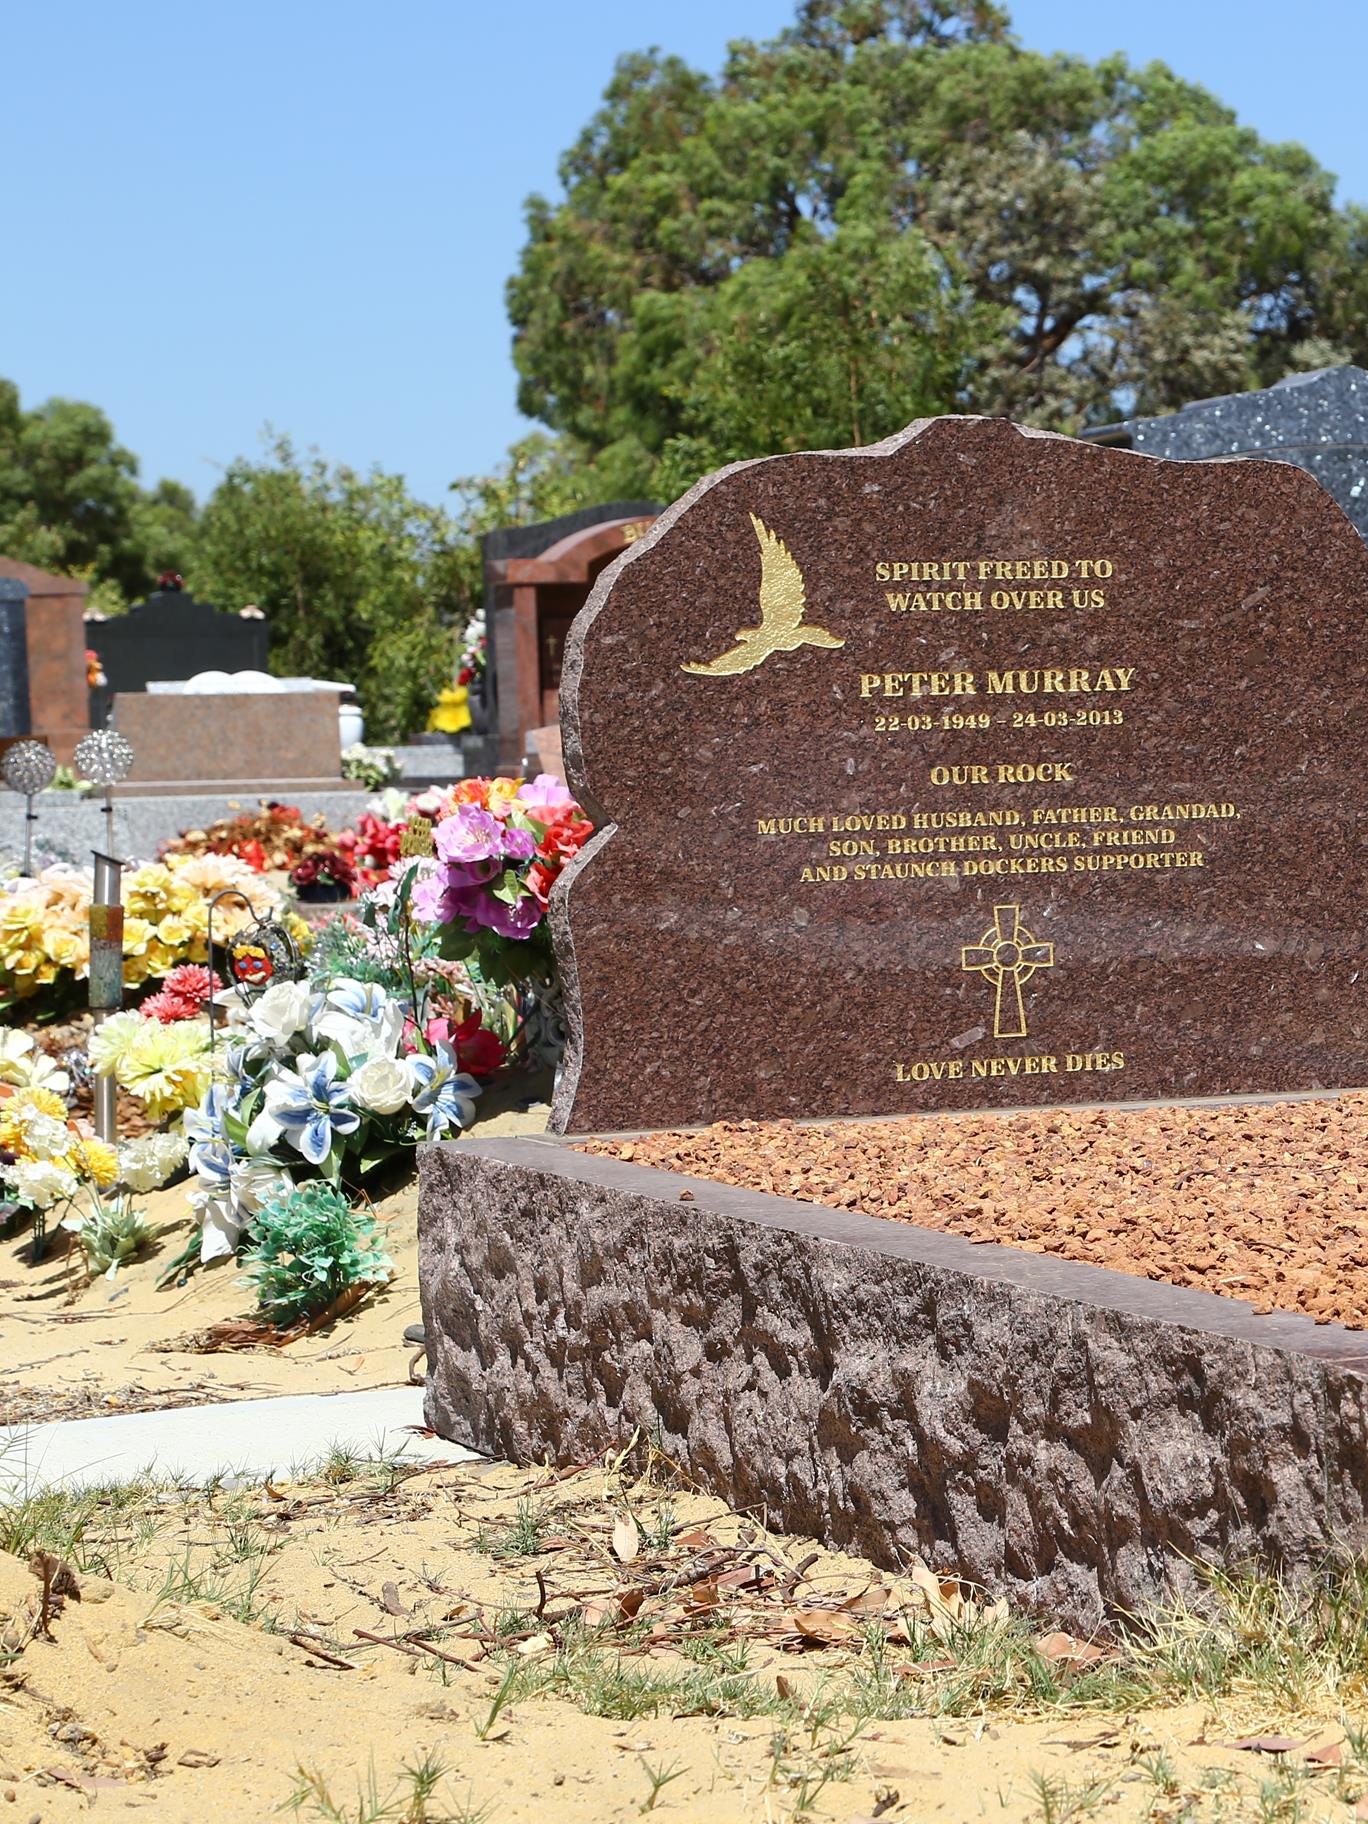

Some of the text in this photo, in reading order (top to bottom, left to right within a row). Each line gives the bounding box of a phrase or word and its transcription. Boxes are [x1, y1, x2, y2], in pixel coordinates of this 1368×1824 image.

[876, 559, 1113, 580] SPIRIT FREED TO
[885, 588, 1104, 610] WATCH OVER US
[859, 667, 1134, 696] PETER MURRAY
[875, 713, 990, 730] 22-03-1949
[1013, 709, 1123, 727] 24-03-2013
[931, 763, 1072, 784] OUR ROCK
[758, 803, 1240, 832] MUCH LOVED HUSBAND, FATHER, GRANDAD,
[829, 827, 1176, 856] SON, BROTHER, UNCLE, FRIEND
[801, 850, 1204, 880] AND STAUNCH DOCKERS SUPPORTER
[894, 1052, 1126, 1082] LOVE NEVER DIES
